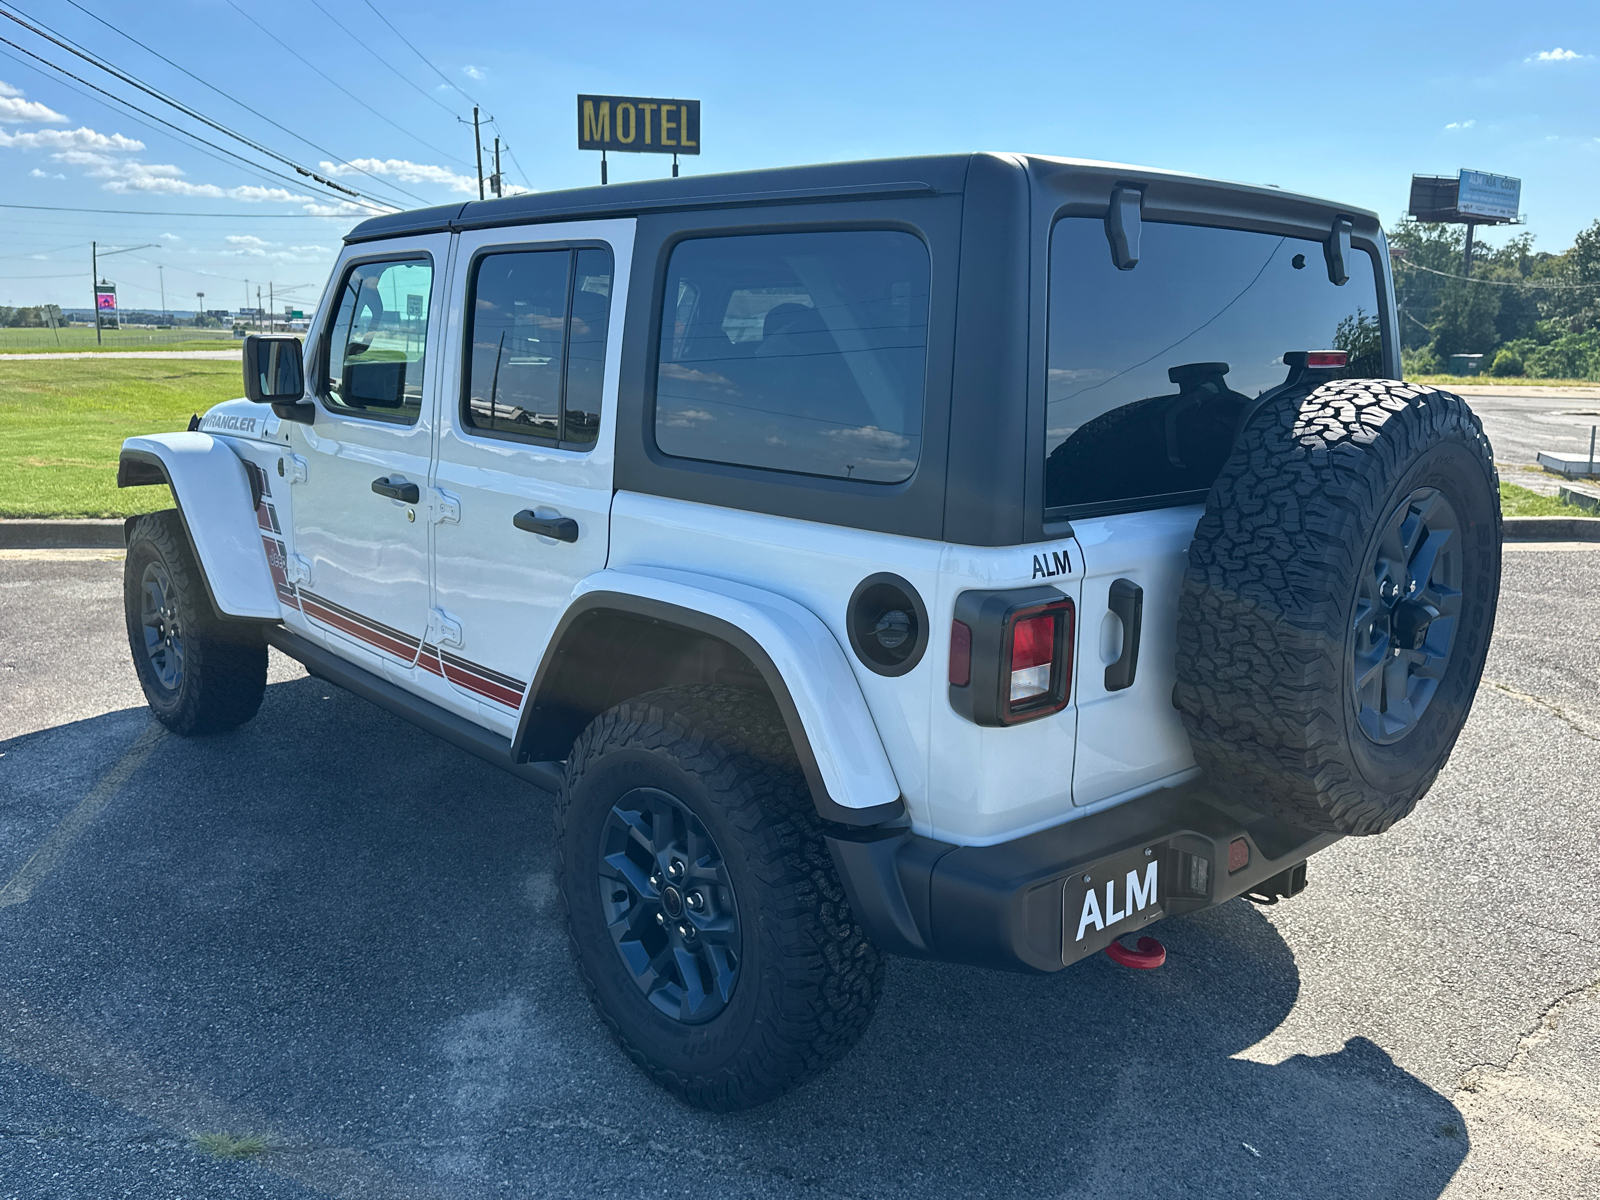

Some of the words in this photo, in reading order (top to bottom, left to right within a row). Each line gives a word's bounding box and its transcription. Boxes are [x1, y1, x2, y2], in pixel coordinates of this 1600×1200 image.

[583, 100, 697, 147] MOTEL
[1469, 174, 1483, 185] ALM
[1485, 176, 1497, 188] KIA
[409, 306, 420, 314] 35
[204, 414, 257, 433] WRANGLER
[269, 549, 287, 571] Jeep
[1032, 550, 1072, 580] ALM
[1075, 860, 1158, 942] ALM
